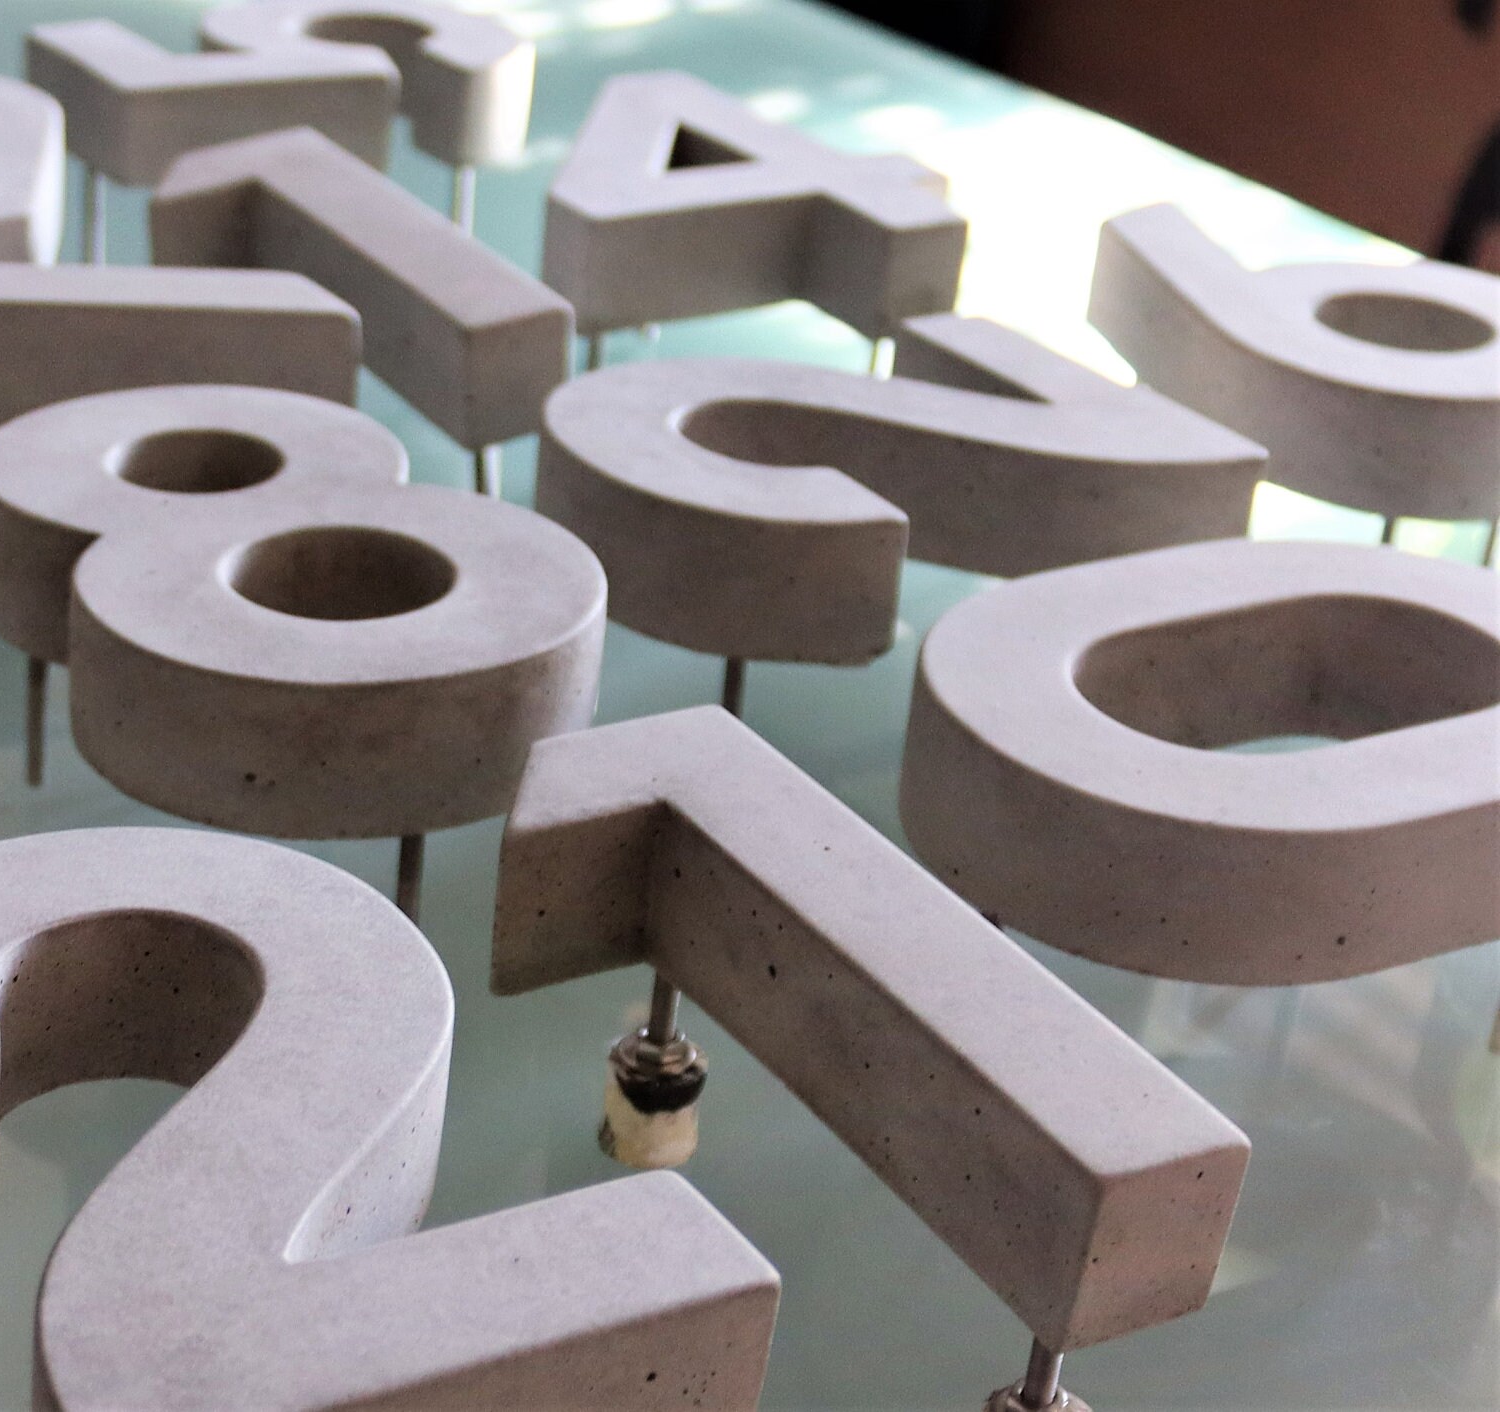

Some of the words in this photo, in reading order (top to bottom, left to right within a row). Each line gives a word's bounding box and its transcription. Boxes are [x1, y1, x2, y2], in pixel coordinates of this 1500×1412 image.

[148, 124, 575, 451] 1
[540, 72, 968, 338] 4
[536, 313, 1268, 665] 2
[902, 537, 1500, 986] 0
[490, 704, 1252, 1352] 1
